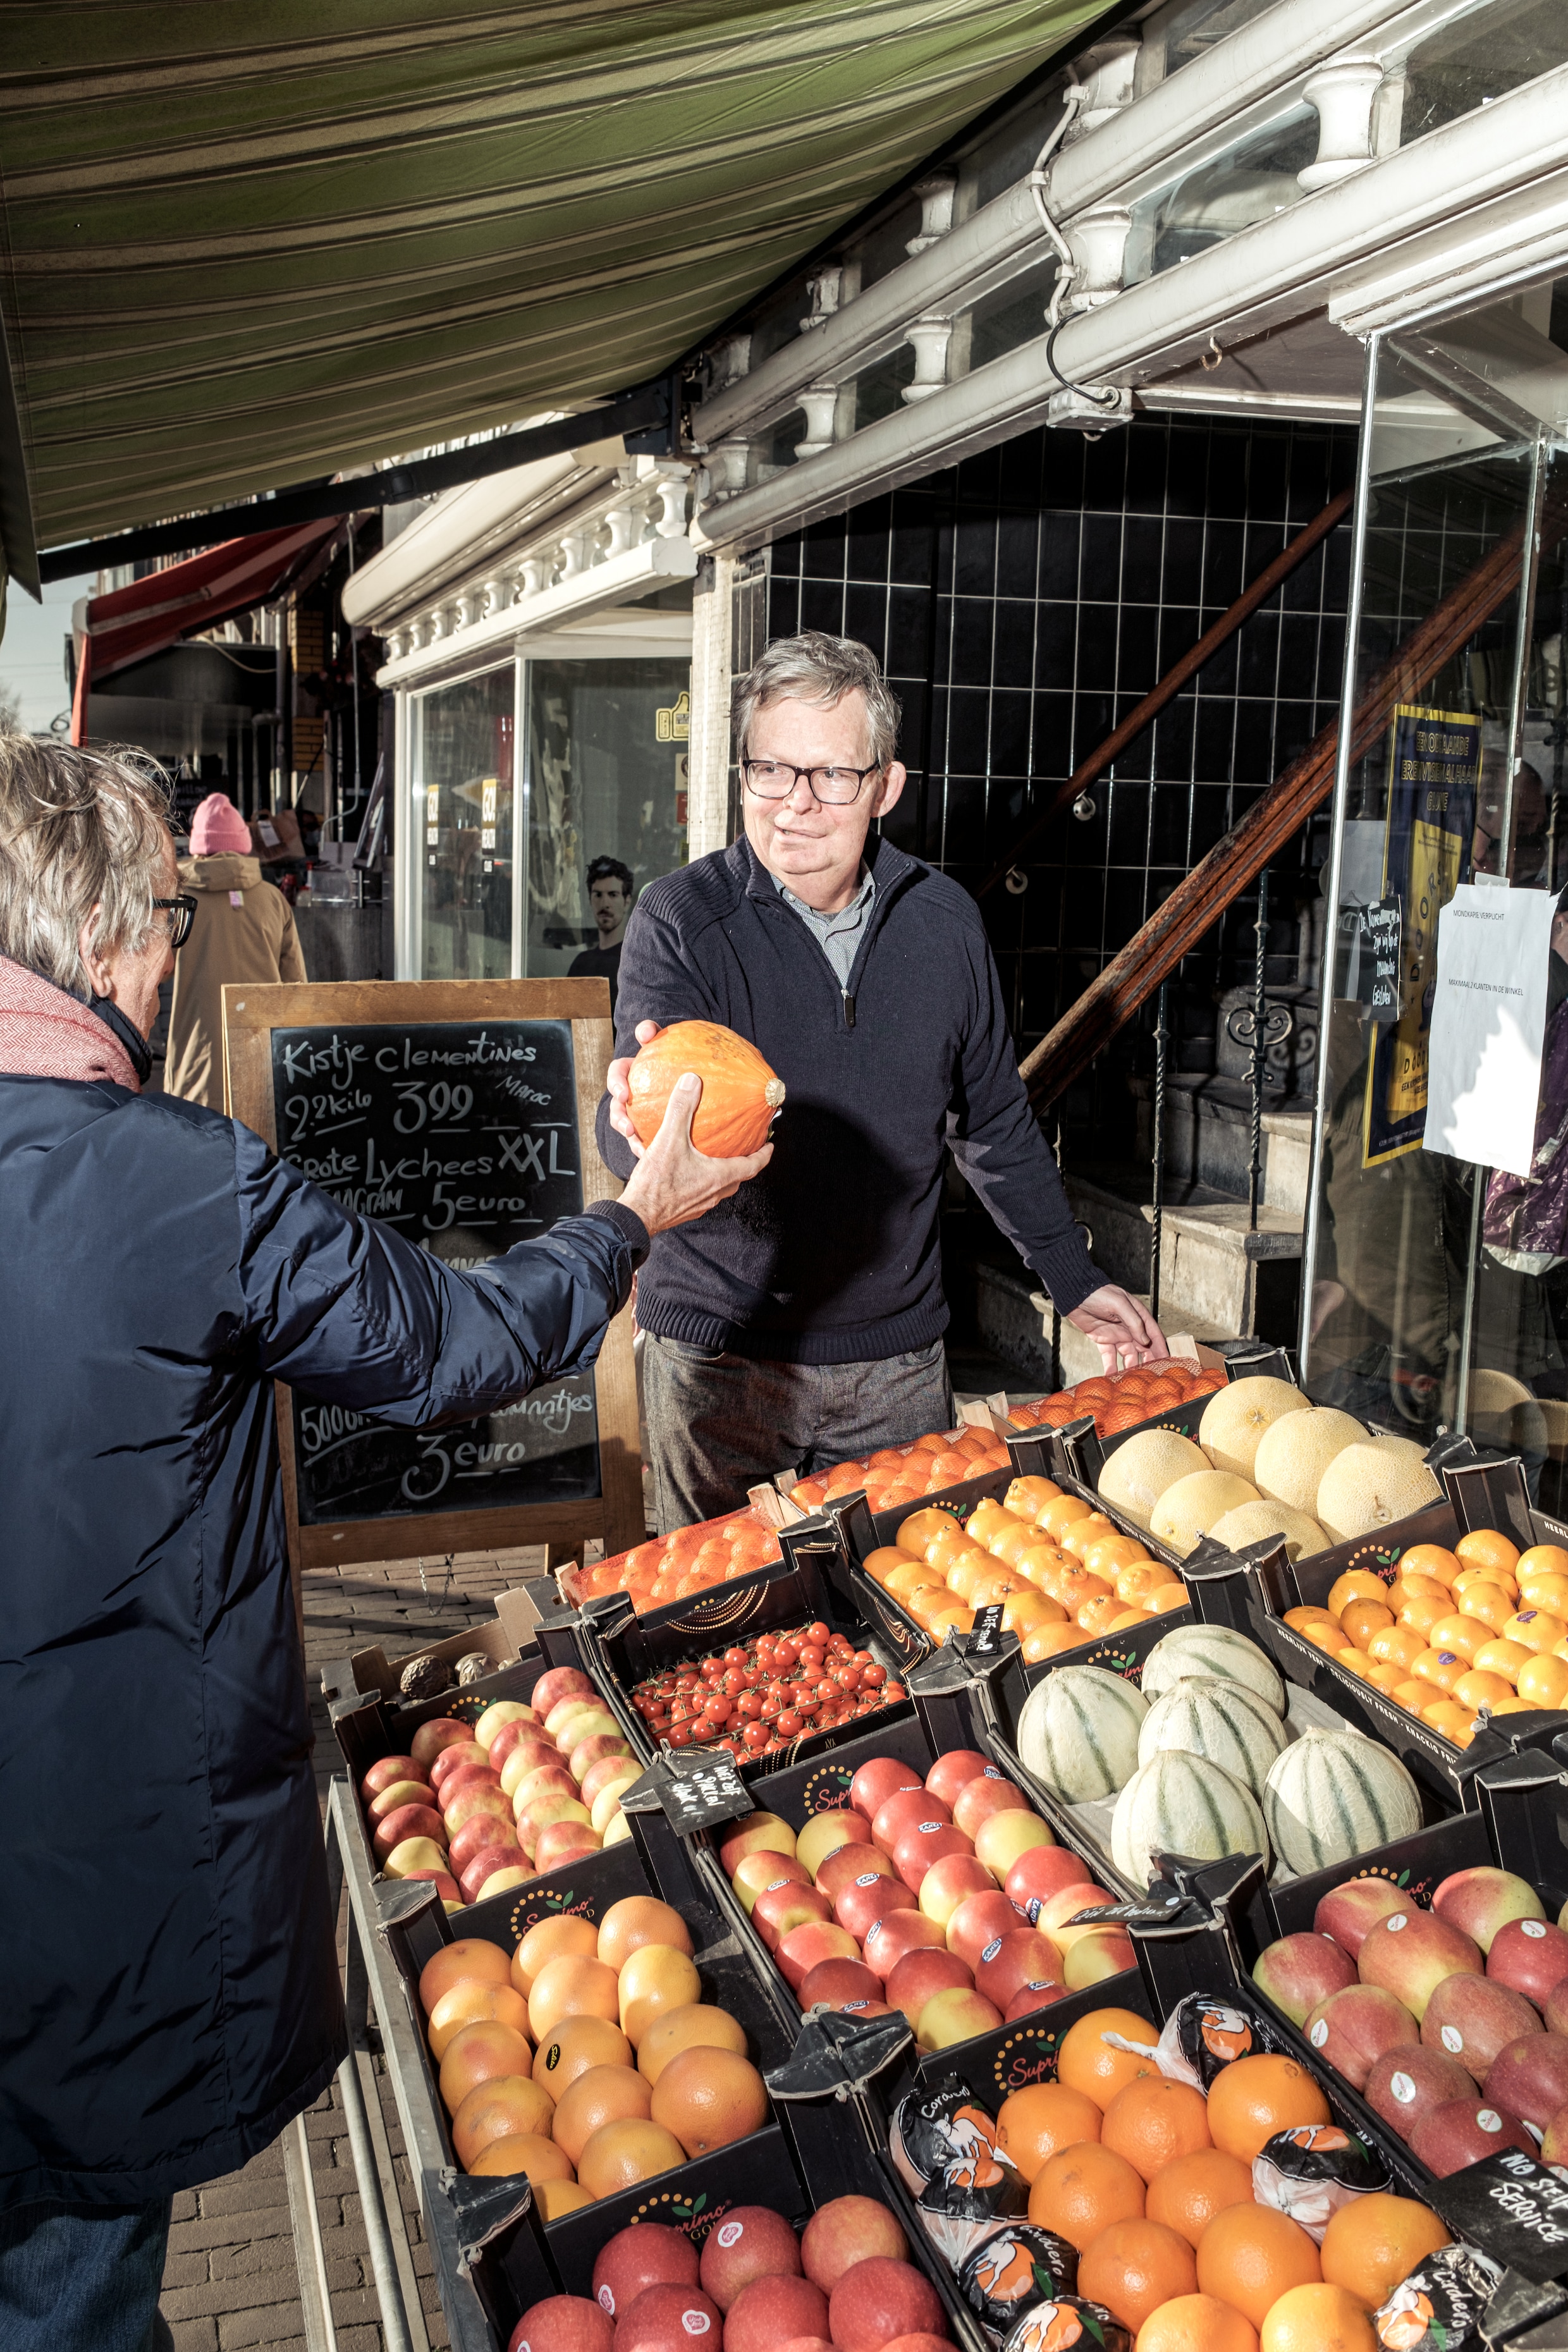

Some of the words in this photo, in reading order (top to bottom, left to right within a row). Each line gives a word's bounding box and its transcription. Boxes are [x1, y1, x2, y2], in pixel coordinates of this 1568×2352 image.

[1479, 912, 1505, 921] VERPLICHT
[1449, 979, 1470, 988] MAXIMAAL
[1473, 983, 1491, 991] KLANTEN
[1505, 987, 1523, 996] WINKEL
[283, 1034, 368, 1091] Kistje
[392, 1081, 474, 1133] 399
[365, 1137, 493, 1191] Lychees
[498, 1130, 576, 1181] XXL
[454, 1442, 525, 1466] euro
[1277, 1627, 1308, 1655] HEERLIJK
[1308, 1651, 1325, 1668] VERS
[1330, 1668, 1373, 1705] DELICIOUSLY
[1375, 1701, 1399, 1724] FRESH
[1405, 1724, 1440, 1755] KNACKIG
[919, 1822, 942, 1832] KANZI
[768, 1880, 789, 1890] KANZI
[856, 1873, 879, 1886] KANZI
[1030, 1899, 1041, 1922] KANZI
[867, 1921, 881, 1942] KANZI
[983, 1940, 1001, 1961] KANZI
[1029, 1980, 1053, 1990] KANZI
[844, 2001, 866, 2011] KANZI
[1500, 2154, 1536, 2175] NO
